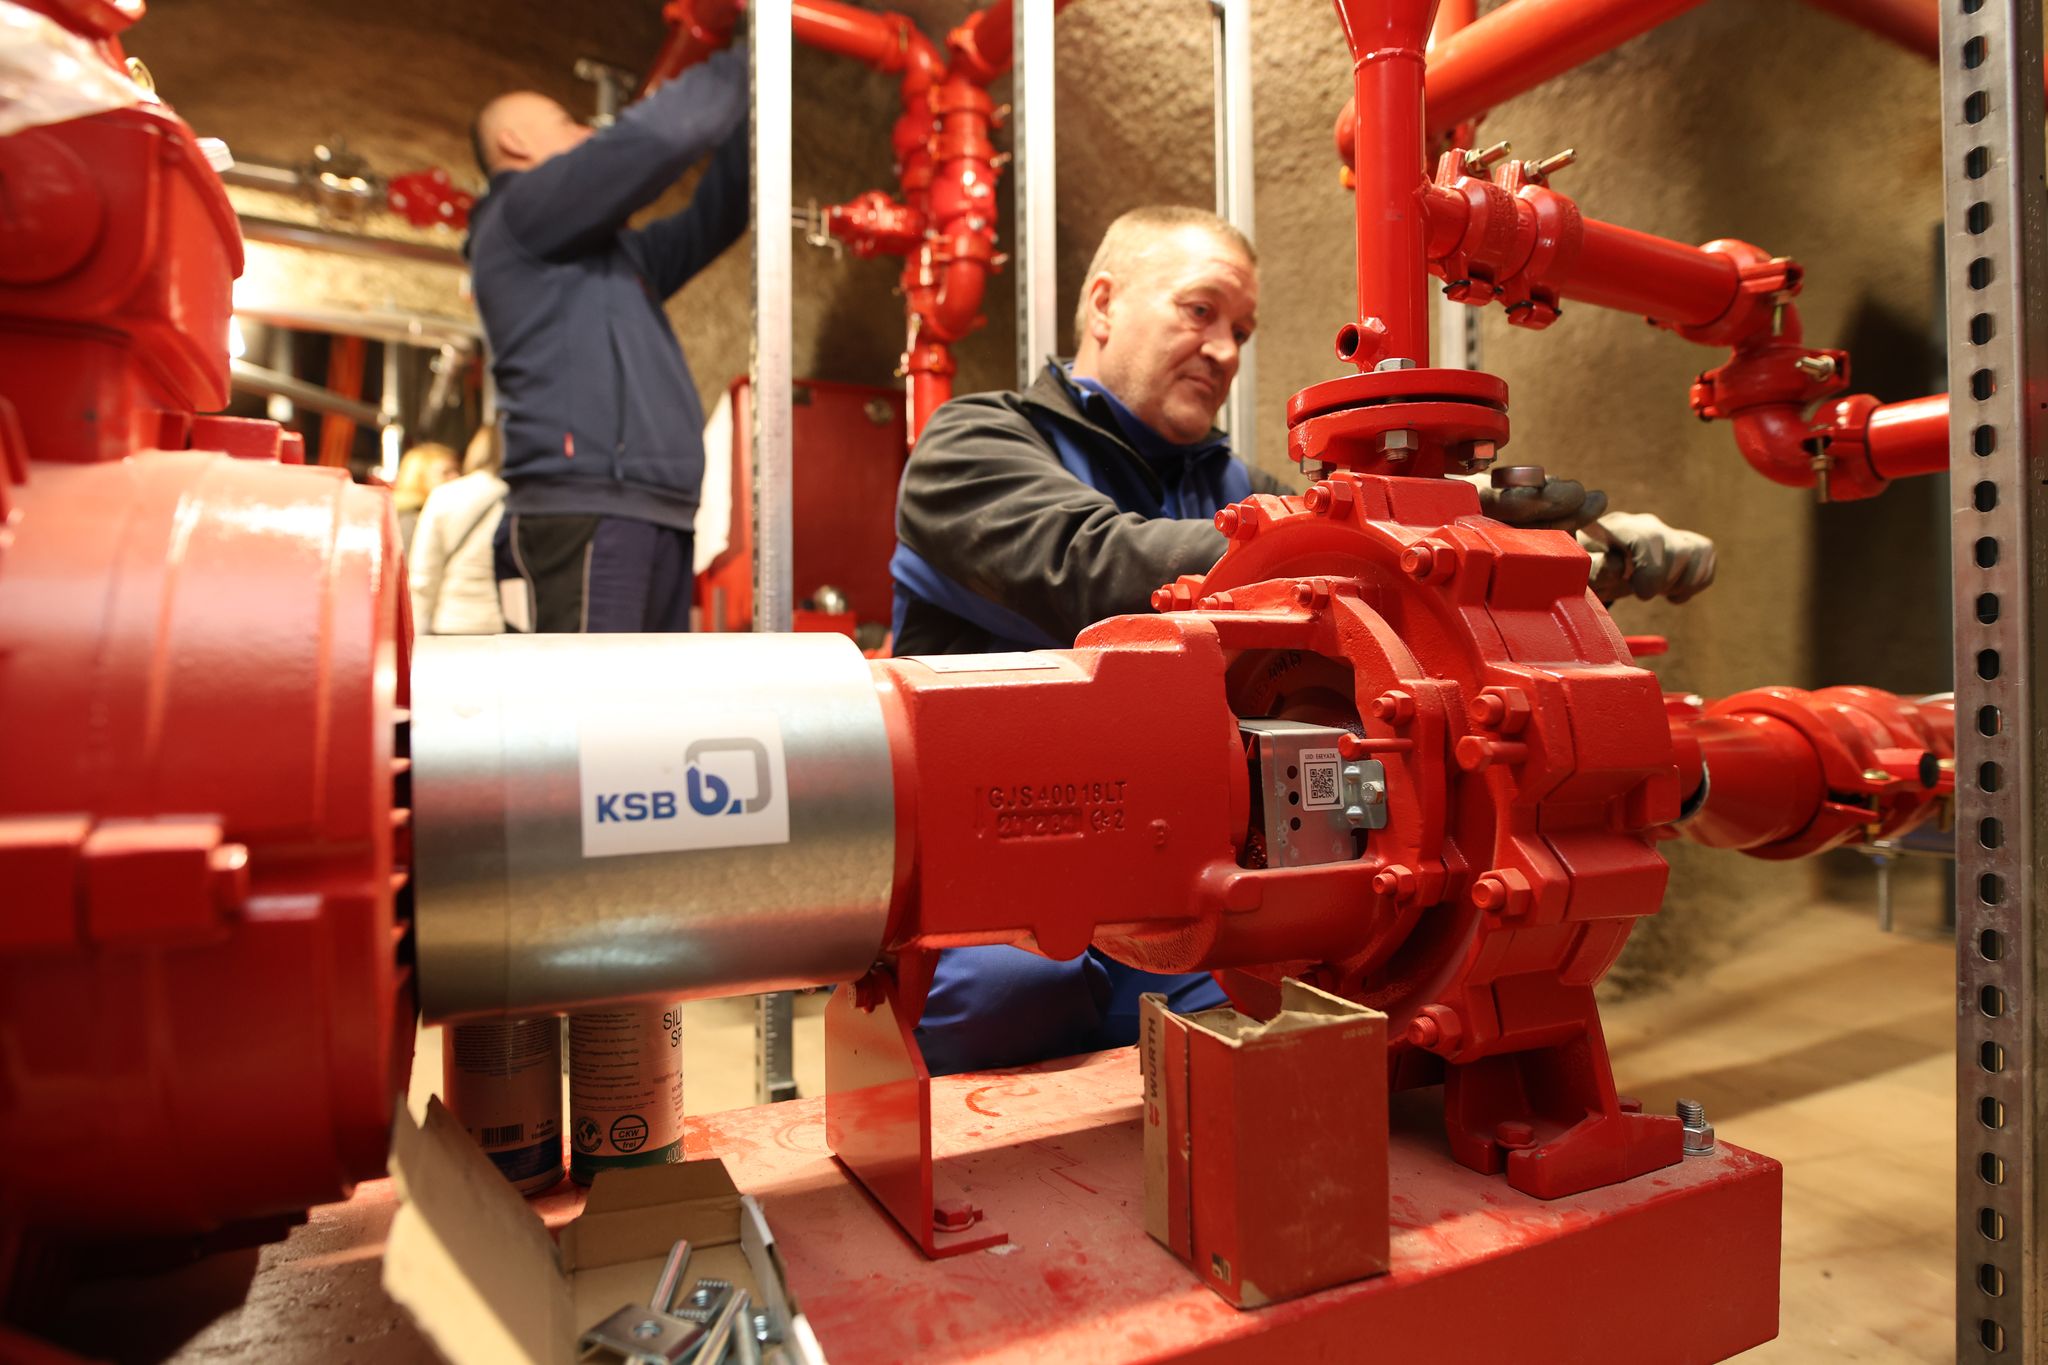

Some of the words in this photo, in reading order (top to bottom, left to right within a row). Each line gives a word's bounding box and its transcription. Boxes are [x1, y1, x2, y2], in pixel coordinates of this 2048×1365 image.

[596, 791, 677, 823] KSB
[618, 1128, 640, 1139] CKW
[622, 1140, 637, 1150] frei
